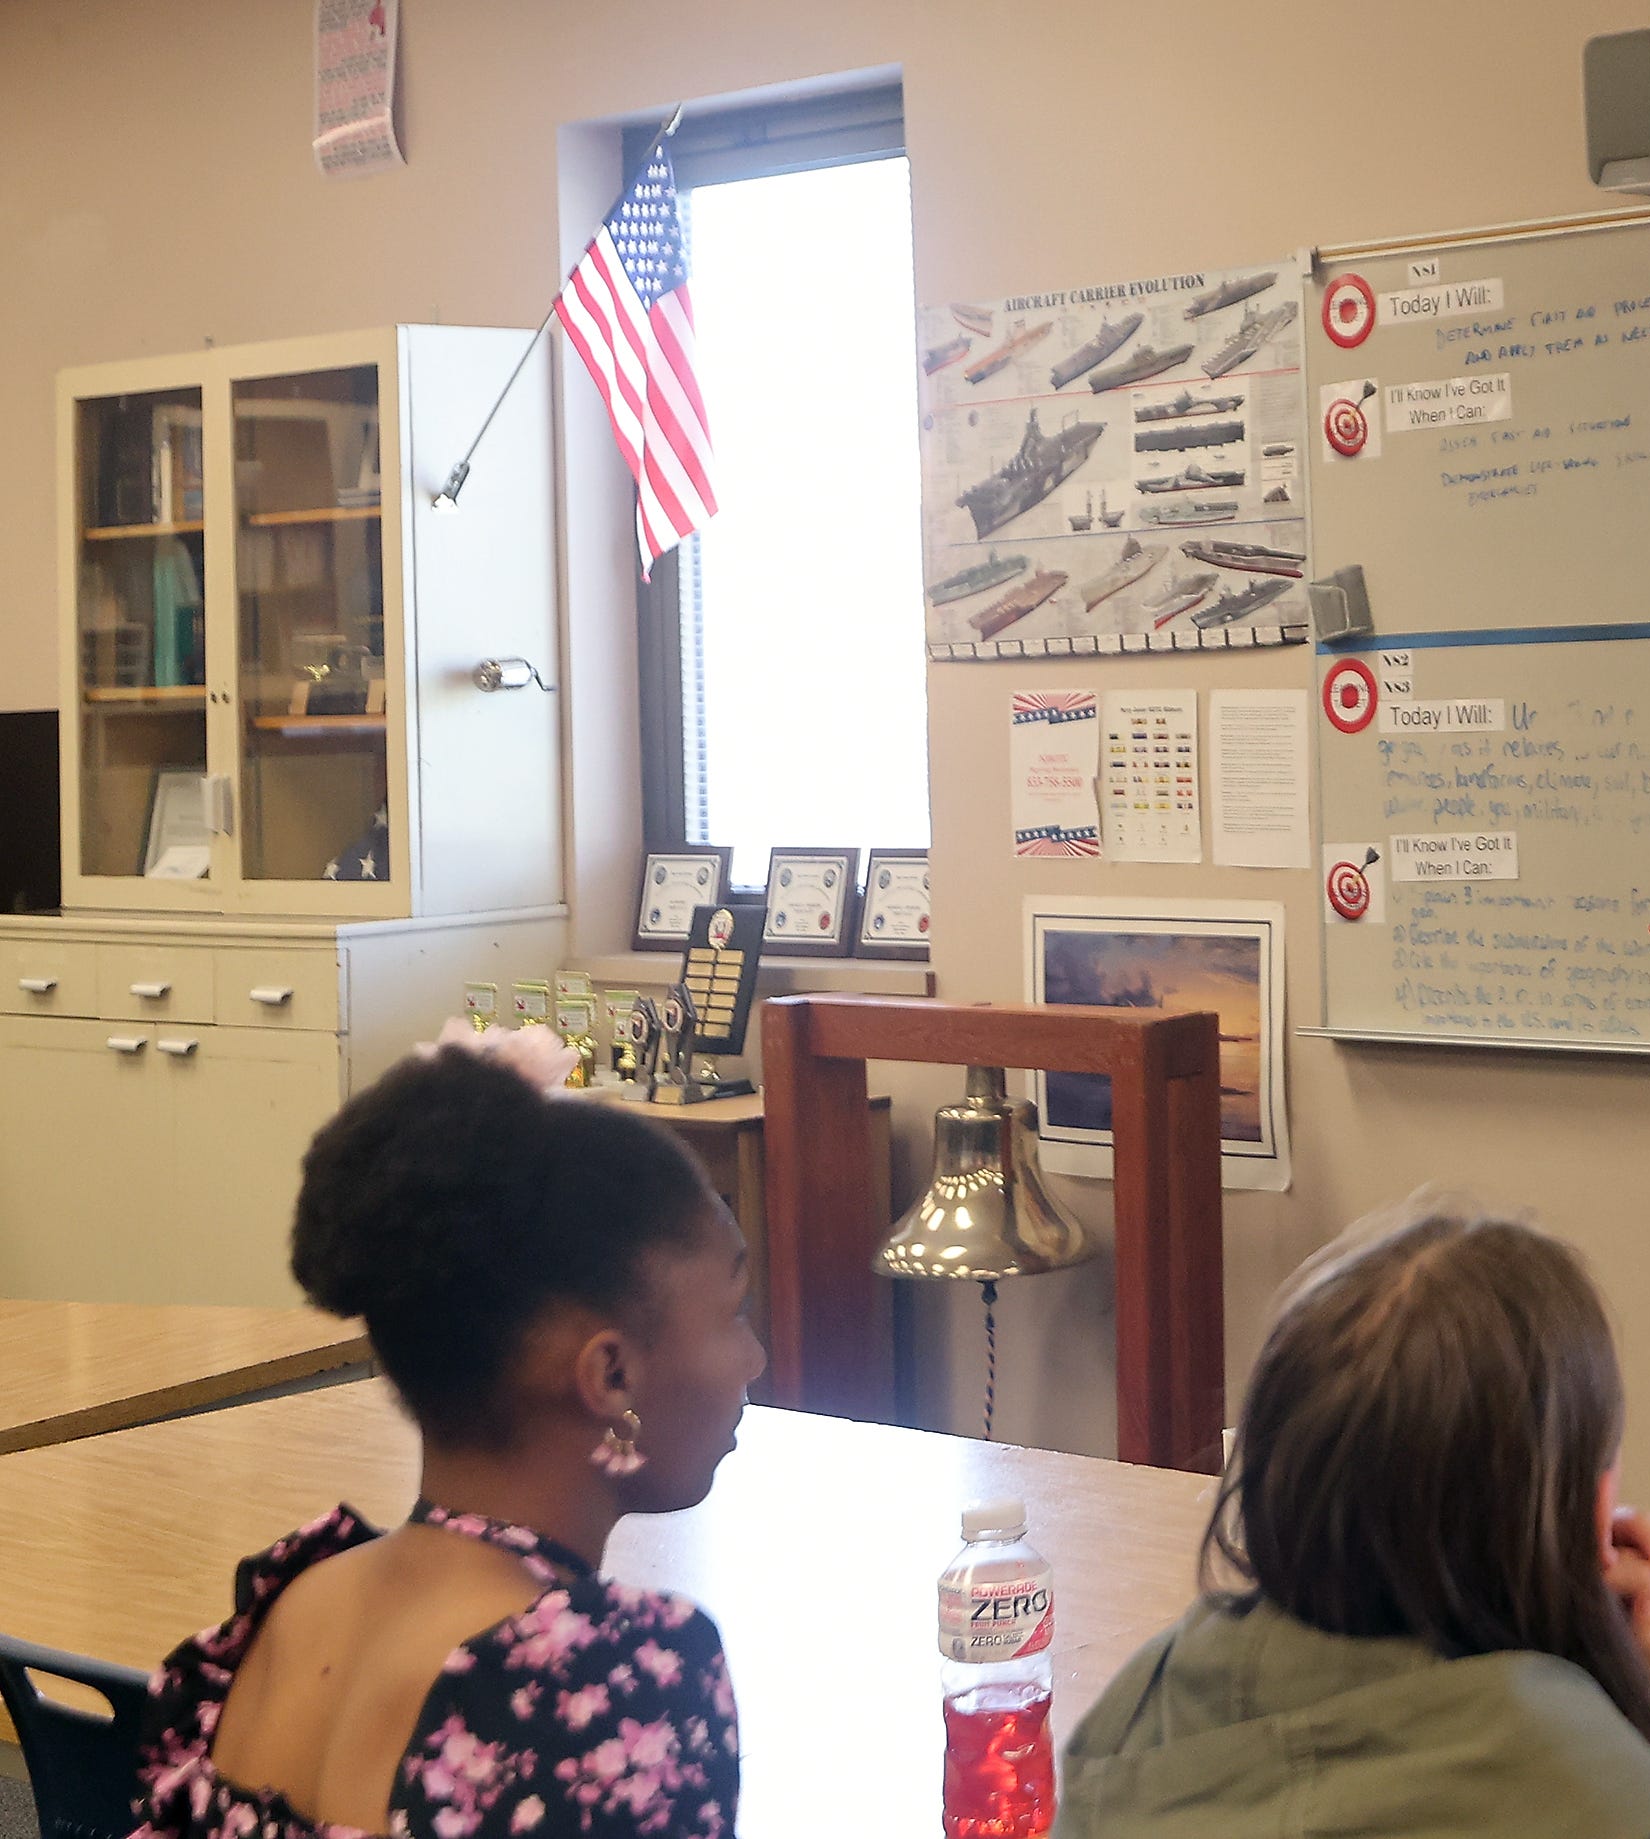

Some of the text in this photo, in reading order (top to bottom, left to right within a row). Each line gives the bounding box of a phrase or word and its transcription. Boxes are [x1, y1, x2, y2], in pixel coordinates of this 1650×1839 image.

[1005, 274, 1204, 312] AIRCRAFT CARRIER EVOLUTION
[1390, 293, 1441, 317] Today
[1446, 290, 1450, 309] I
[1456, 286, 1491, 307] Will:
[1407, 385, 1441, 402] Know
[1469, 378, 1495, 397] Got
[1497, 378, 1506, 394] It
[1409, 408, 1445, 426] When
[1457, 403, 1487, 421] Can:
[1390, 706, 1441, 730] Today
[1447, 705, 1451, 724] I
[1456, 704, 1492, 725] Will:
[1412, 840, 1447, 856] Know
[1475, 836, 1501, 853] Got
[1504, 838, 1514, 852] It
[1414, 858, 1491, 877] When I Can:
[971, 1590, 1047, 1620] ZERO
